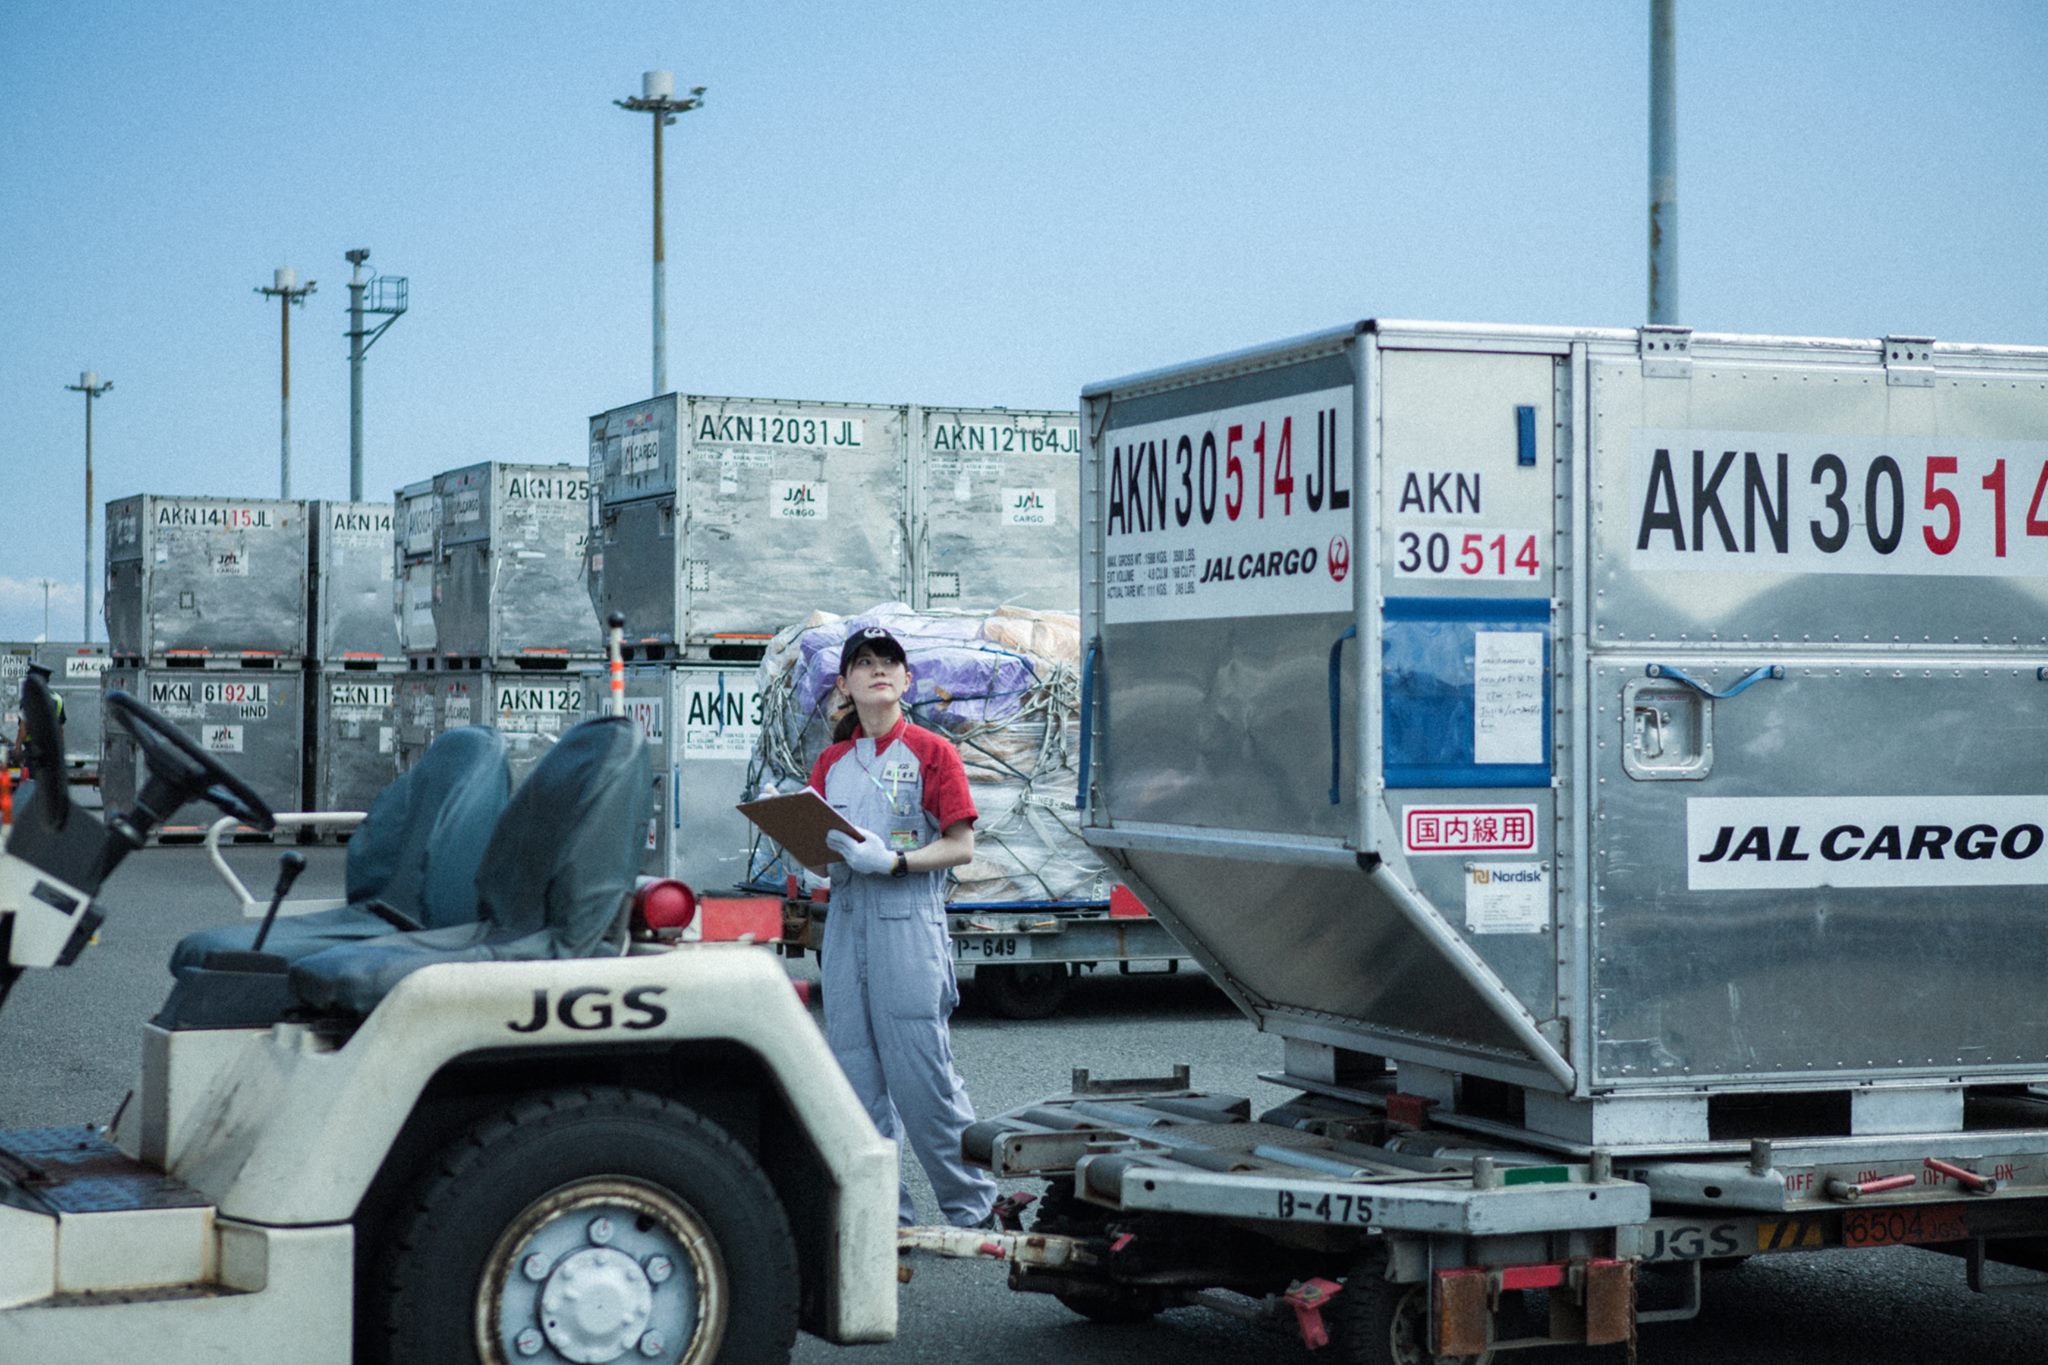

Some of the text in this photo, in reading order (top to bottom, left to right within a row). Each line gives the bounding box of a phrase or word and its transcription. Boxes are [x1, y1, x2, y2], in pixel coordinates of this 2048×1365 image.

[699, 414, 861, 447] AKN12031JL
[1107, 408, 1350, 537] AKN30514JL
[784, 484, 815, 506] JAL
[1014, 491, 1044, 512] JAL
[1399, 472, 1480, 514] AKN
[160, 507, 271, 527] AKN14115JL
[334, 513, 395, 531] AKN14
[783, 509, 815, 517] CARGO
[1013, 515, 1044, 523] CARGO
[1398, 532, 1540, 577] 30514
[153, 684, 266, 703] MKN 6192JL
[333, 687, 394, 704] AKN11
[241, 706, 266, 718] HND
[1415, 815, 1526, 844] 国内線用
[1697, 823, 2045, 863] JAL CARGO
[1493, 869, 1542, 882] Nordisk
[958, 937, 1017, 958] P-649
[507, 986, 668, 1033] JGS
[1786, 1173, 1815, 1191] OFF
[1995, 1163, 2014, 1180] ON
[1278, 1189, 1374, 1223] B-475
[1850, 1210, 1922, 1243] 6504
[1641, 1223, 1739, 1260] JGS
